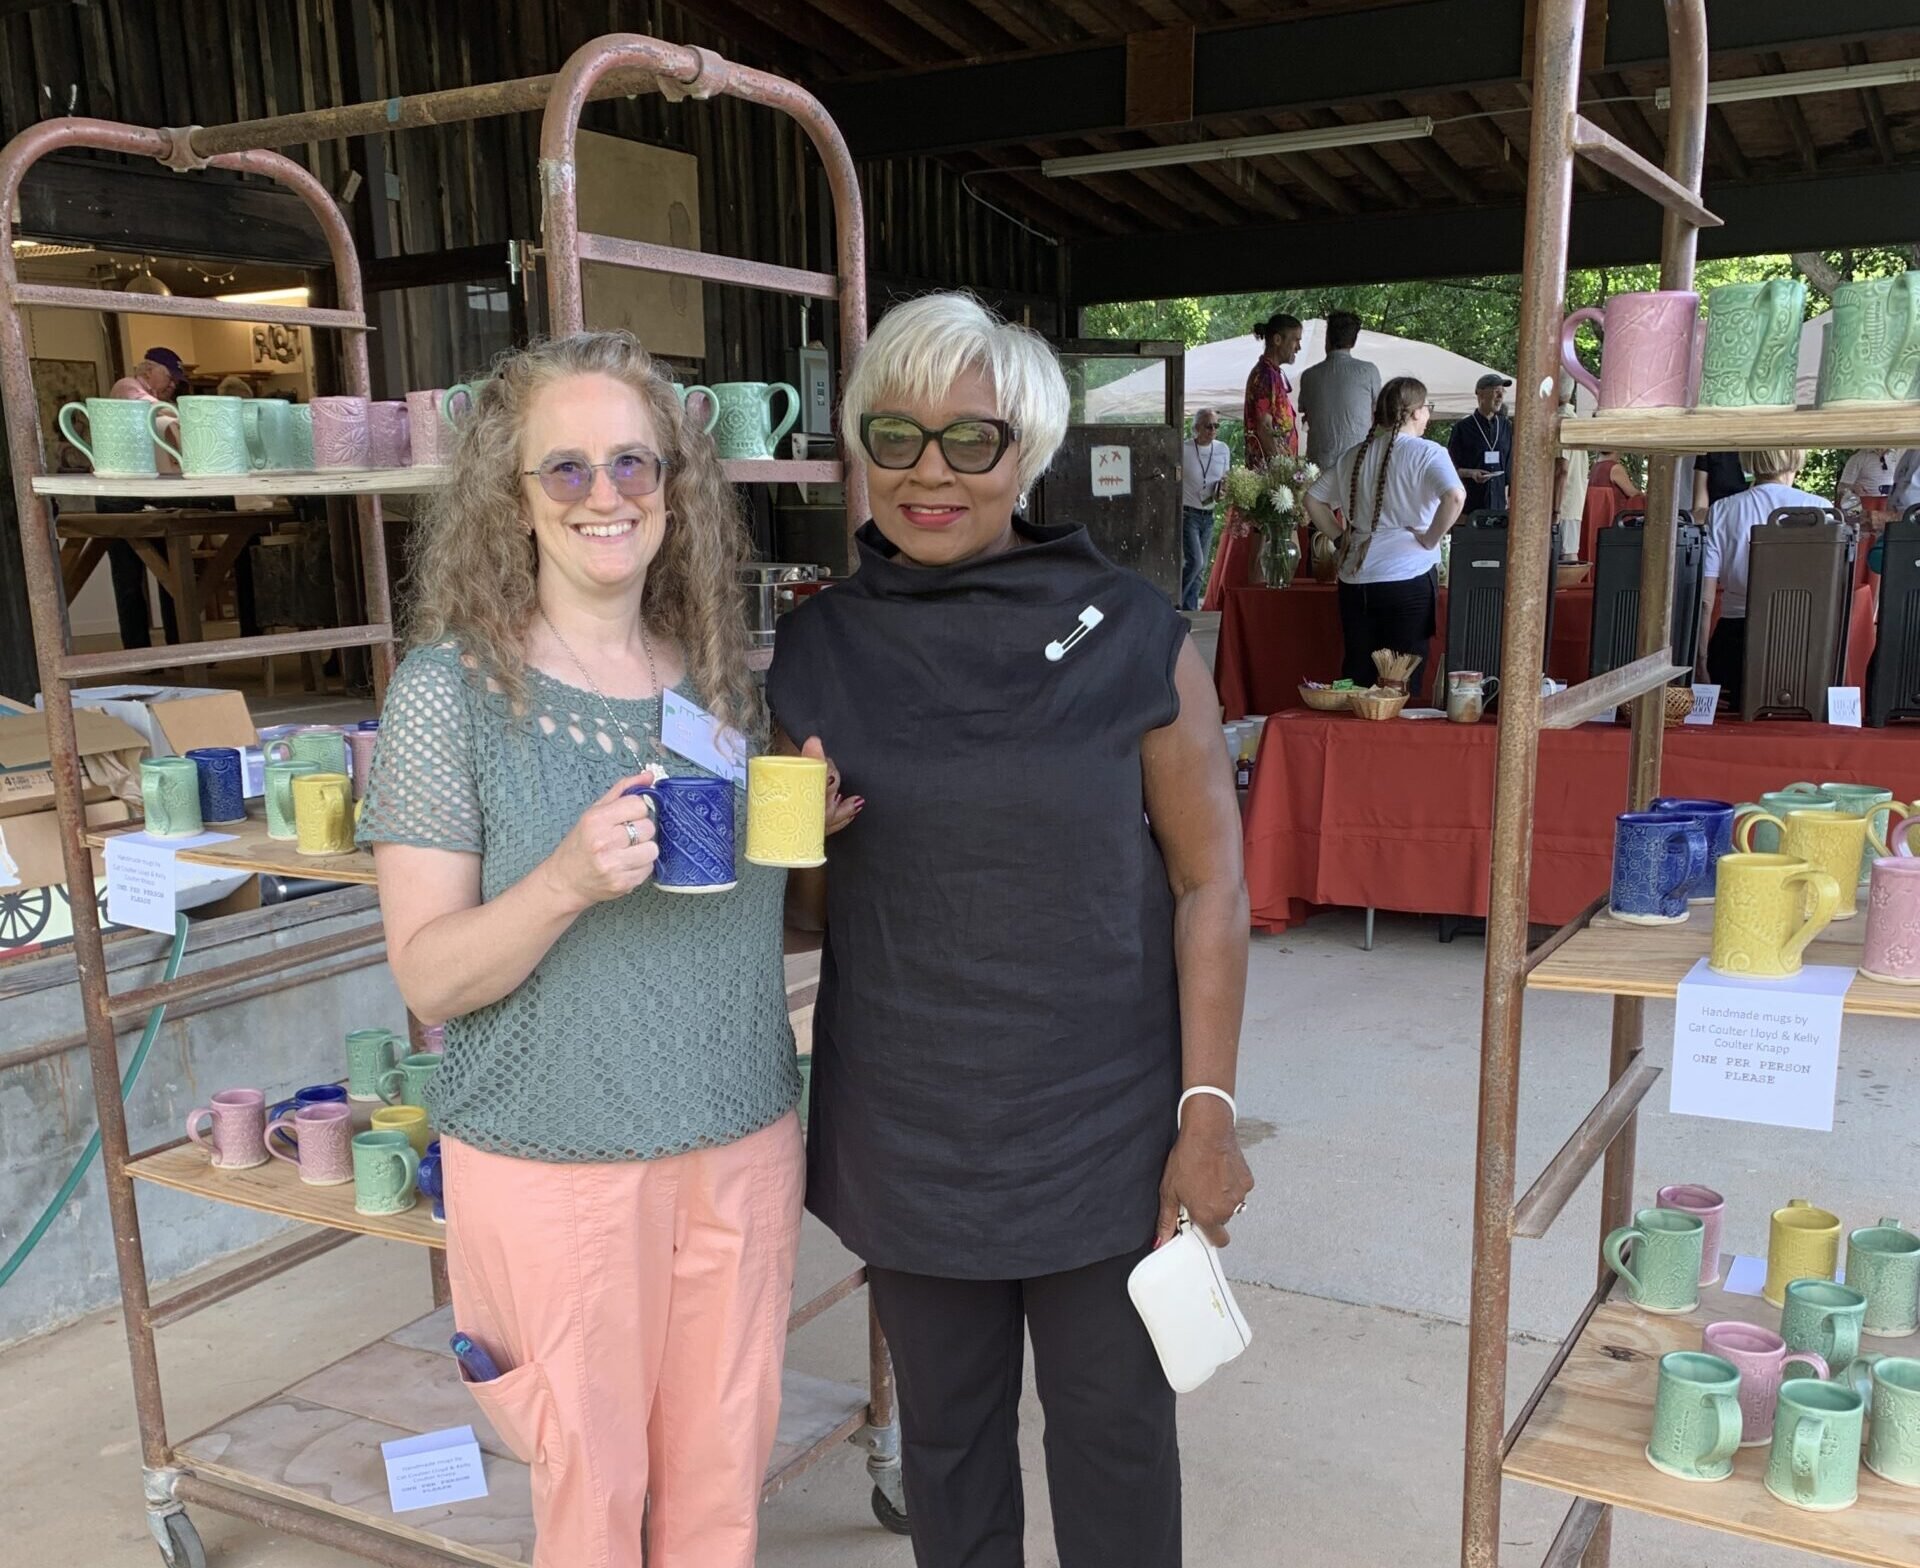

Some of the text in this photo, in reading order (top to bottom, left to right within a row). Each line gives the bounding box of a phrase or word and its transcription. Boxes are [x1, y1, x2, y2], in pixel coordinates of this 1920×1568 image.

[1702, 1006, 1808, 1026] Handmade mugs by
[1688, 1022, 1820, 1045] Cat Coulter Lloyd & Kelly
[1714, 1038, 1790, 1055] Coulter Knapp
[1692, 1054, 1812, 1074] ONE PER PERSON
[1724, 1071, 1776, 1084] PLEASE
